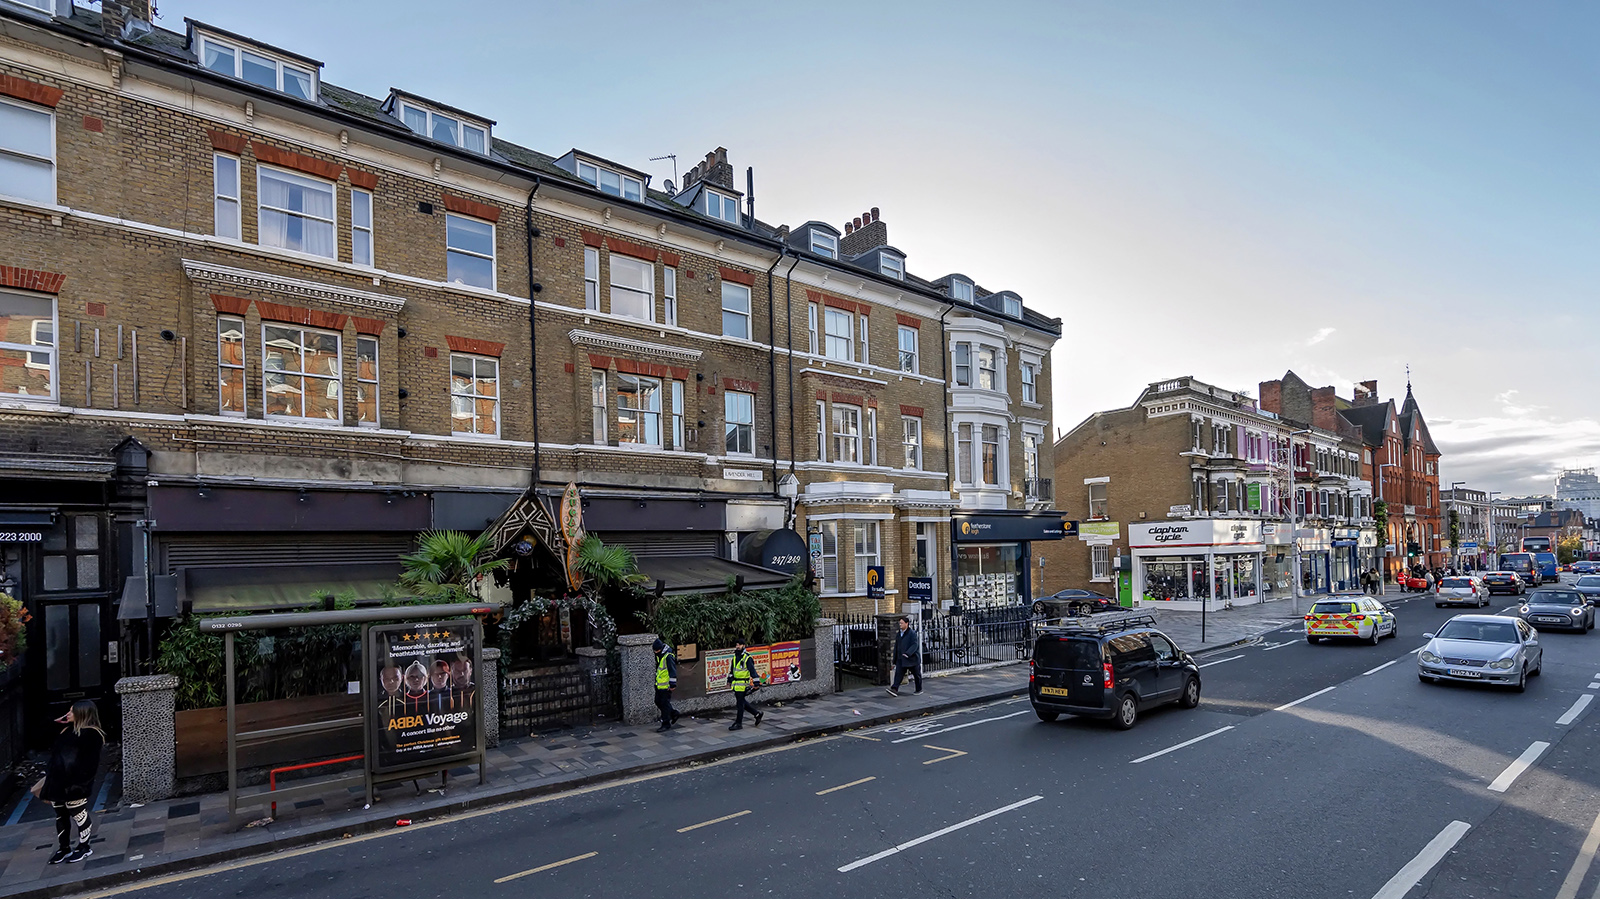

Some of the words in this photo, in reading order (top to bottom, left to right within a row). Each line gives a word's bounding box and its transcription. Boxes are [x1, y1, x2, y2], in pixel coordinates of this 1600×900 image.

[1148, 525, 1189, 535] clapham
[18, 532, 42, 541] 2000
[1155, 533, 1183, 542] cycle
[771, 554, 801, 565] 247/249
[908, 581, 931, 590] Dexters
[427, 641, 450, 649] dazzling
[389, 649, 425, 658] breathtaking
[771, 650, 799, 660] HAPPY
[706, 658, 730, 668] TAPAS
[706, 666, 730, 676] FEAST
[387, 715, 424, 731] ABBA
[425, 711, 468, 726] Voyage
[406, 729, 426, 737] concert
